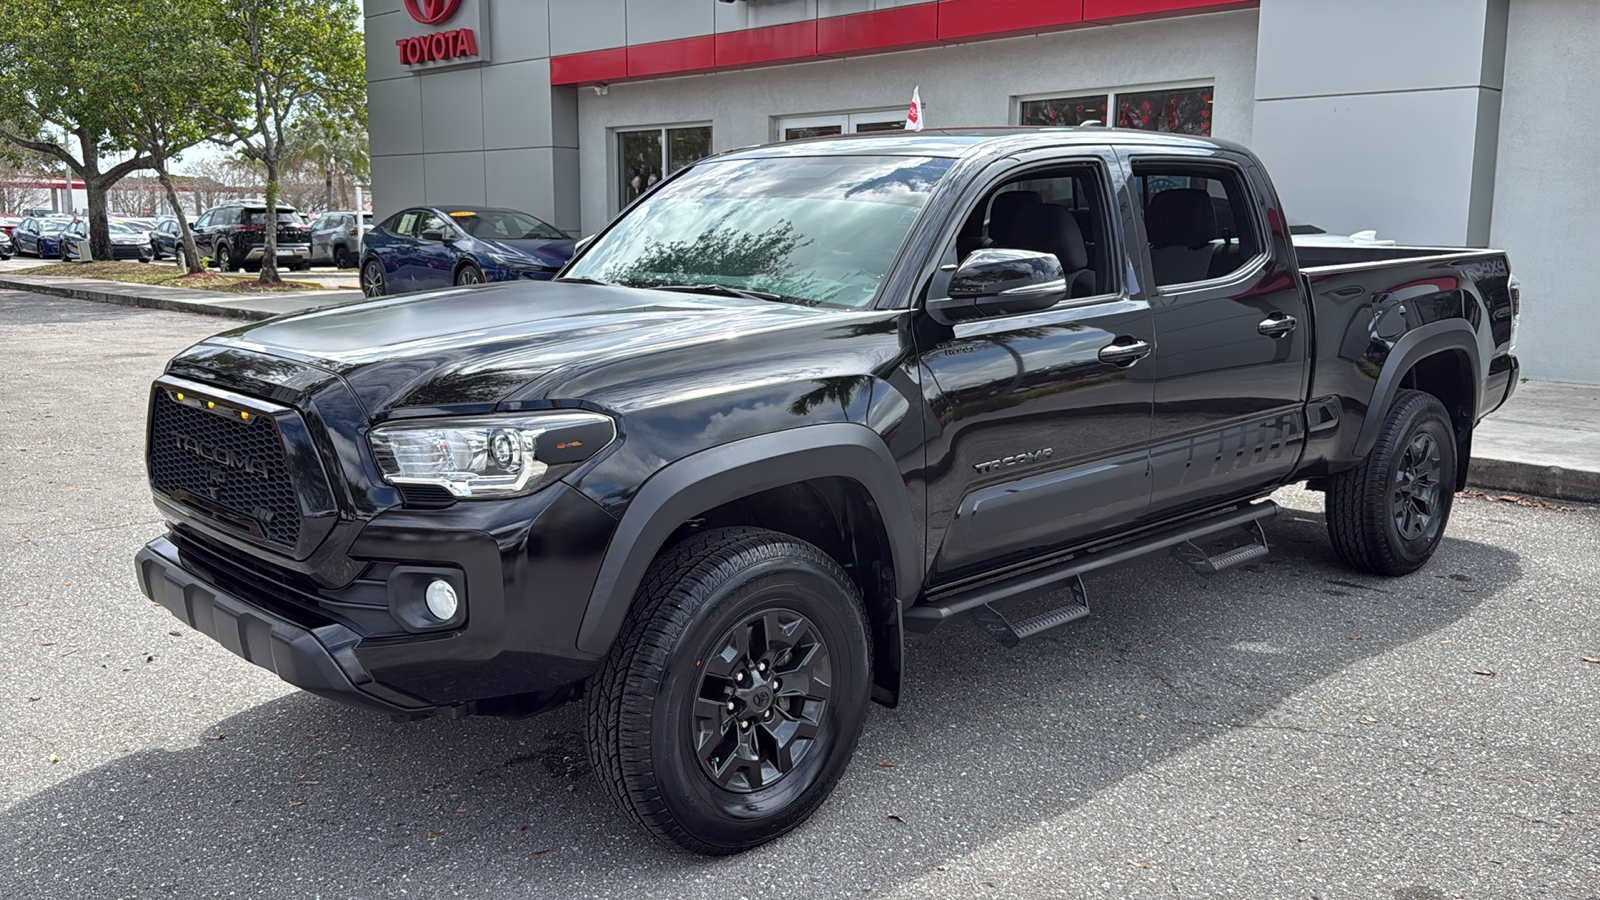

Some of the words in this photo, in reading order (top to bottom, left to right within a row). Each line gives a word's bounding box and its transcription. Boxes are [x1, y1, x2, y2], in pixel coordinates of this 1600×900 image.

[396, 28, 478, 65] TOYOTA
[1454, 262, 1484, 281] TRD
[173, 433, 269, 480] TACOMA
[972, 447, 1053, 474] TACOMA
